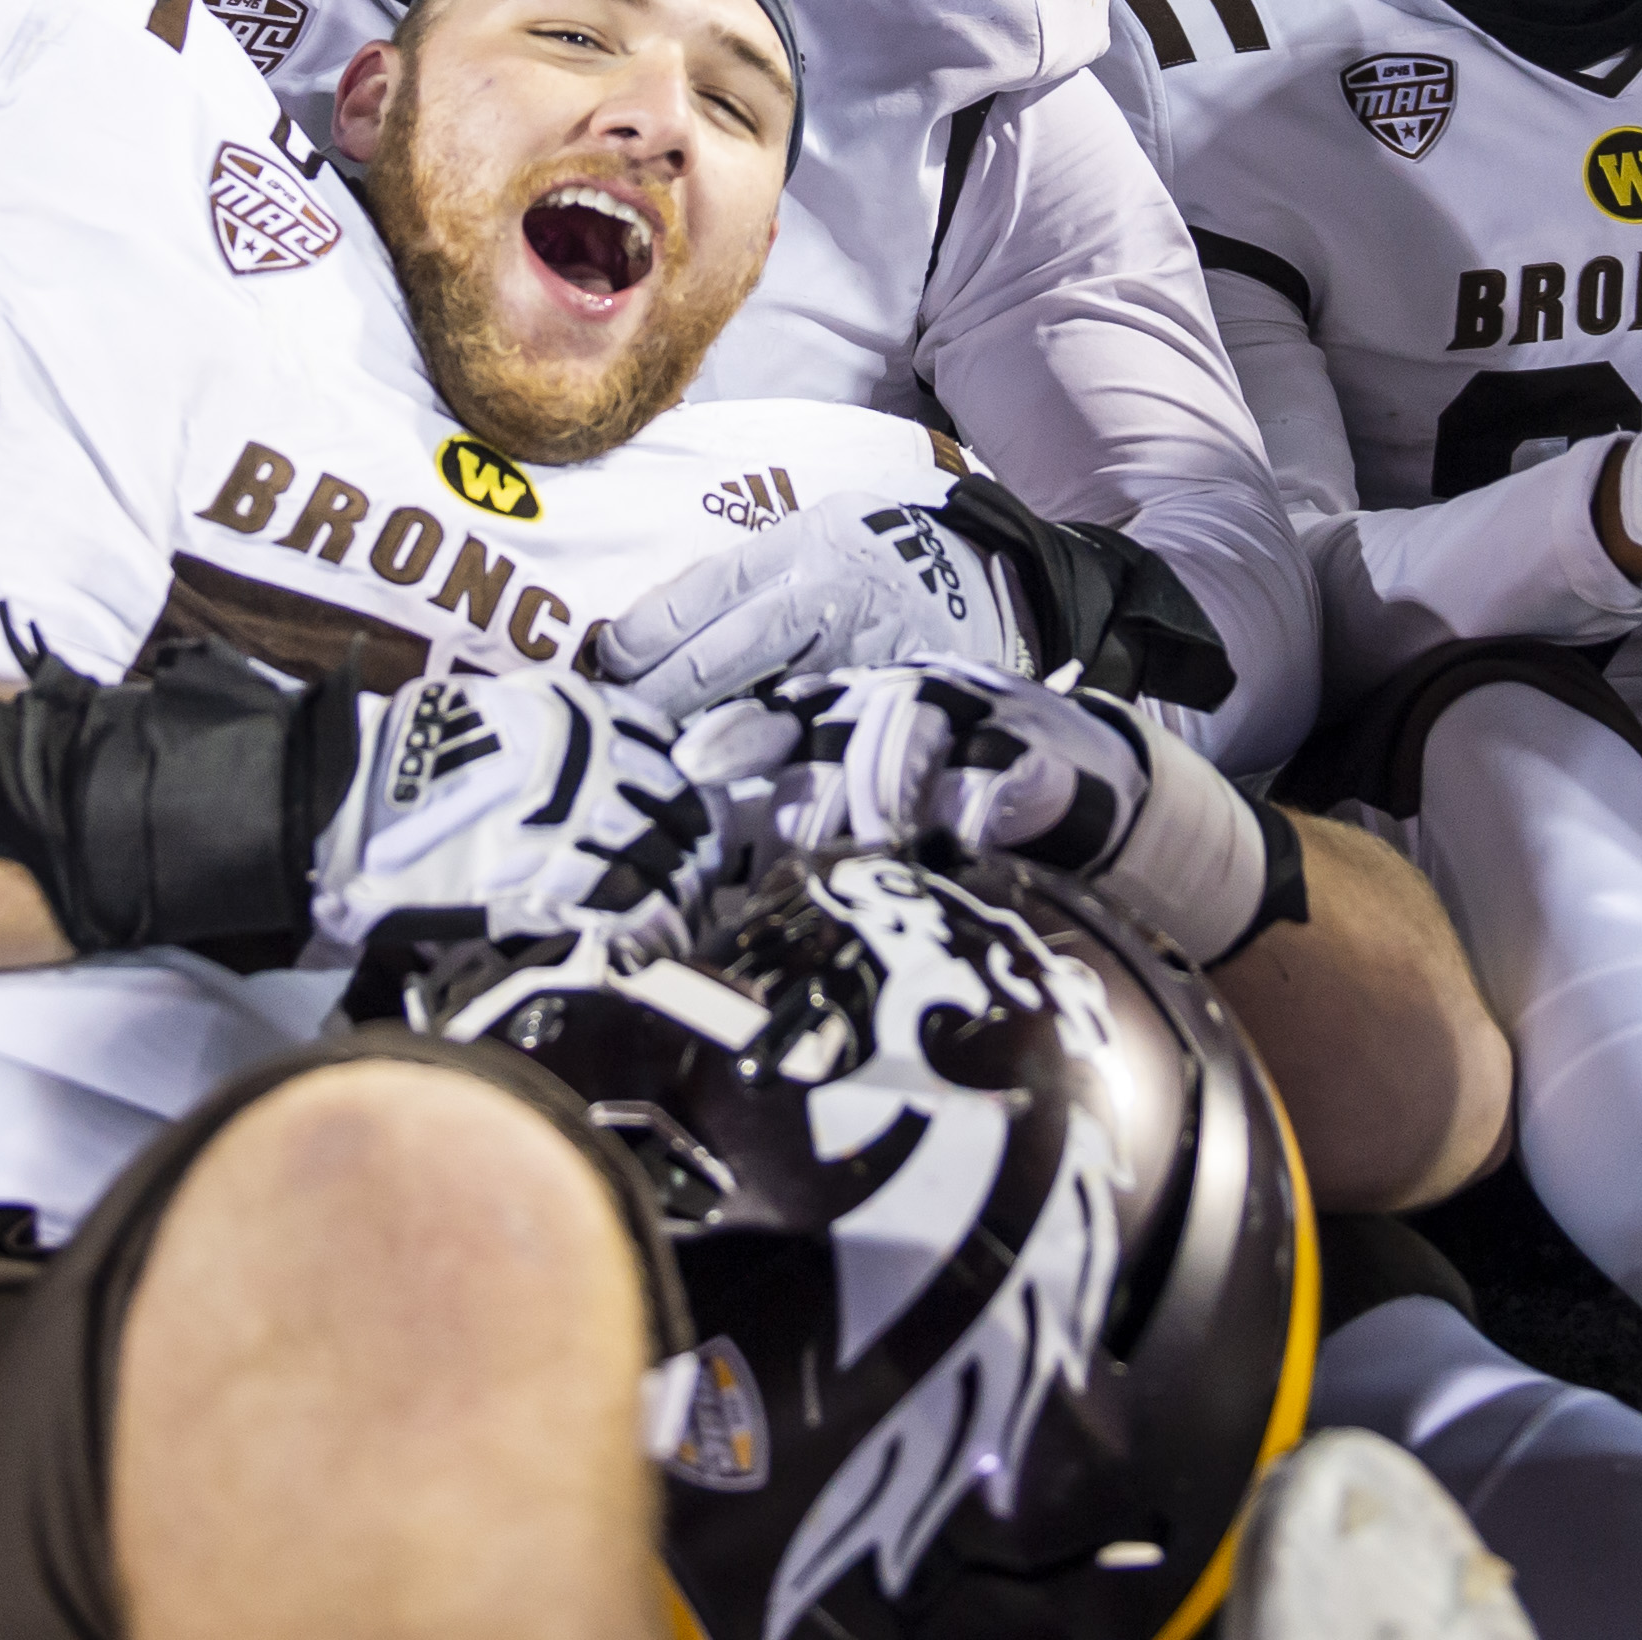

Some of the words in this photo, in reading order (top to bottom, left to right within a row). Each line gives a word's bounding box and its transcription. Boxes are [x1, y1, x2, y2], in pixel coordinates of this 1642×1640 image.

[223, 19, 293, 52] AC
[1355, 83, 1448, 117] MAC
[210, 170, 326, 260] MAC
[457, 446, 526, 514] W
[390, 682, 446, 808] adidas
